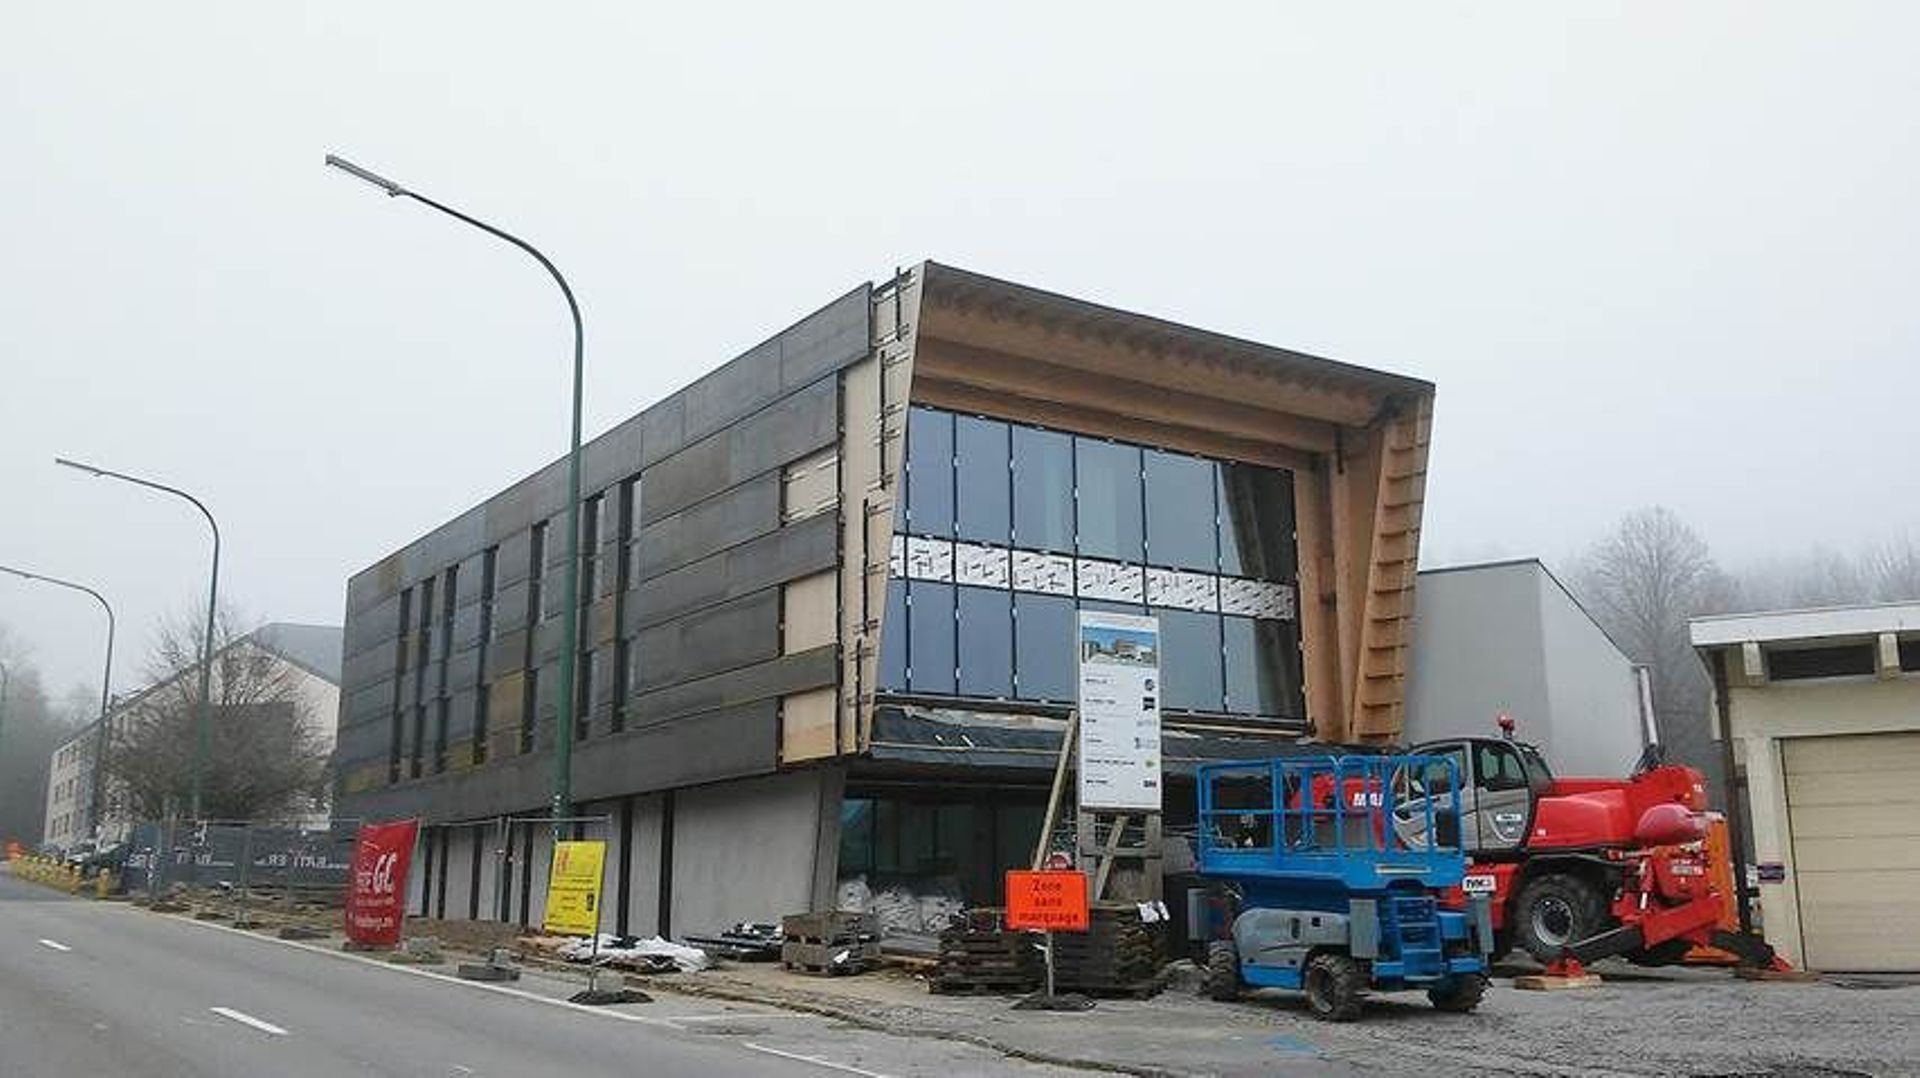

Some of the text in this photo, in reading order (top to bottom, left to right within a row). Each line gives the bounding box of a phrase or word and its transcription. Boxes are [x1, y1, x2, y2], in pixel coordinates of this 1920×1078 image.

[1032, 879, 1062, 892] Zone
[1034, 896, 1062, 907] sans
[1018, 912, 1079, 926] marquage
